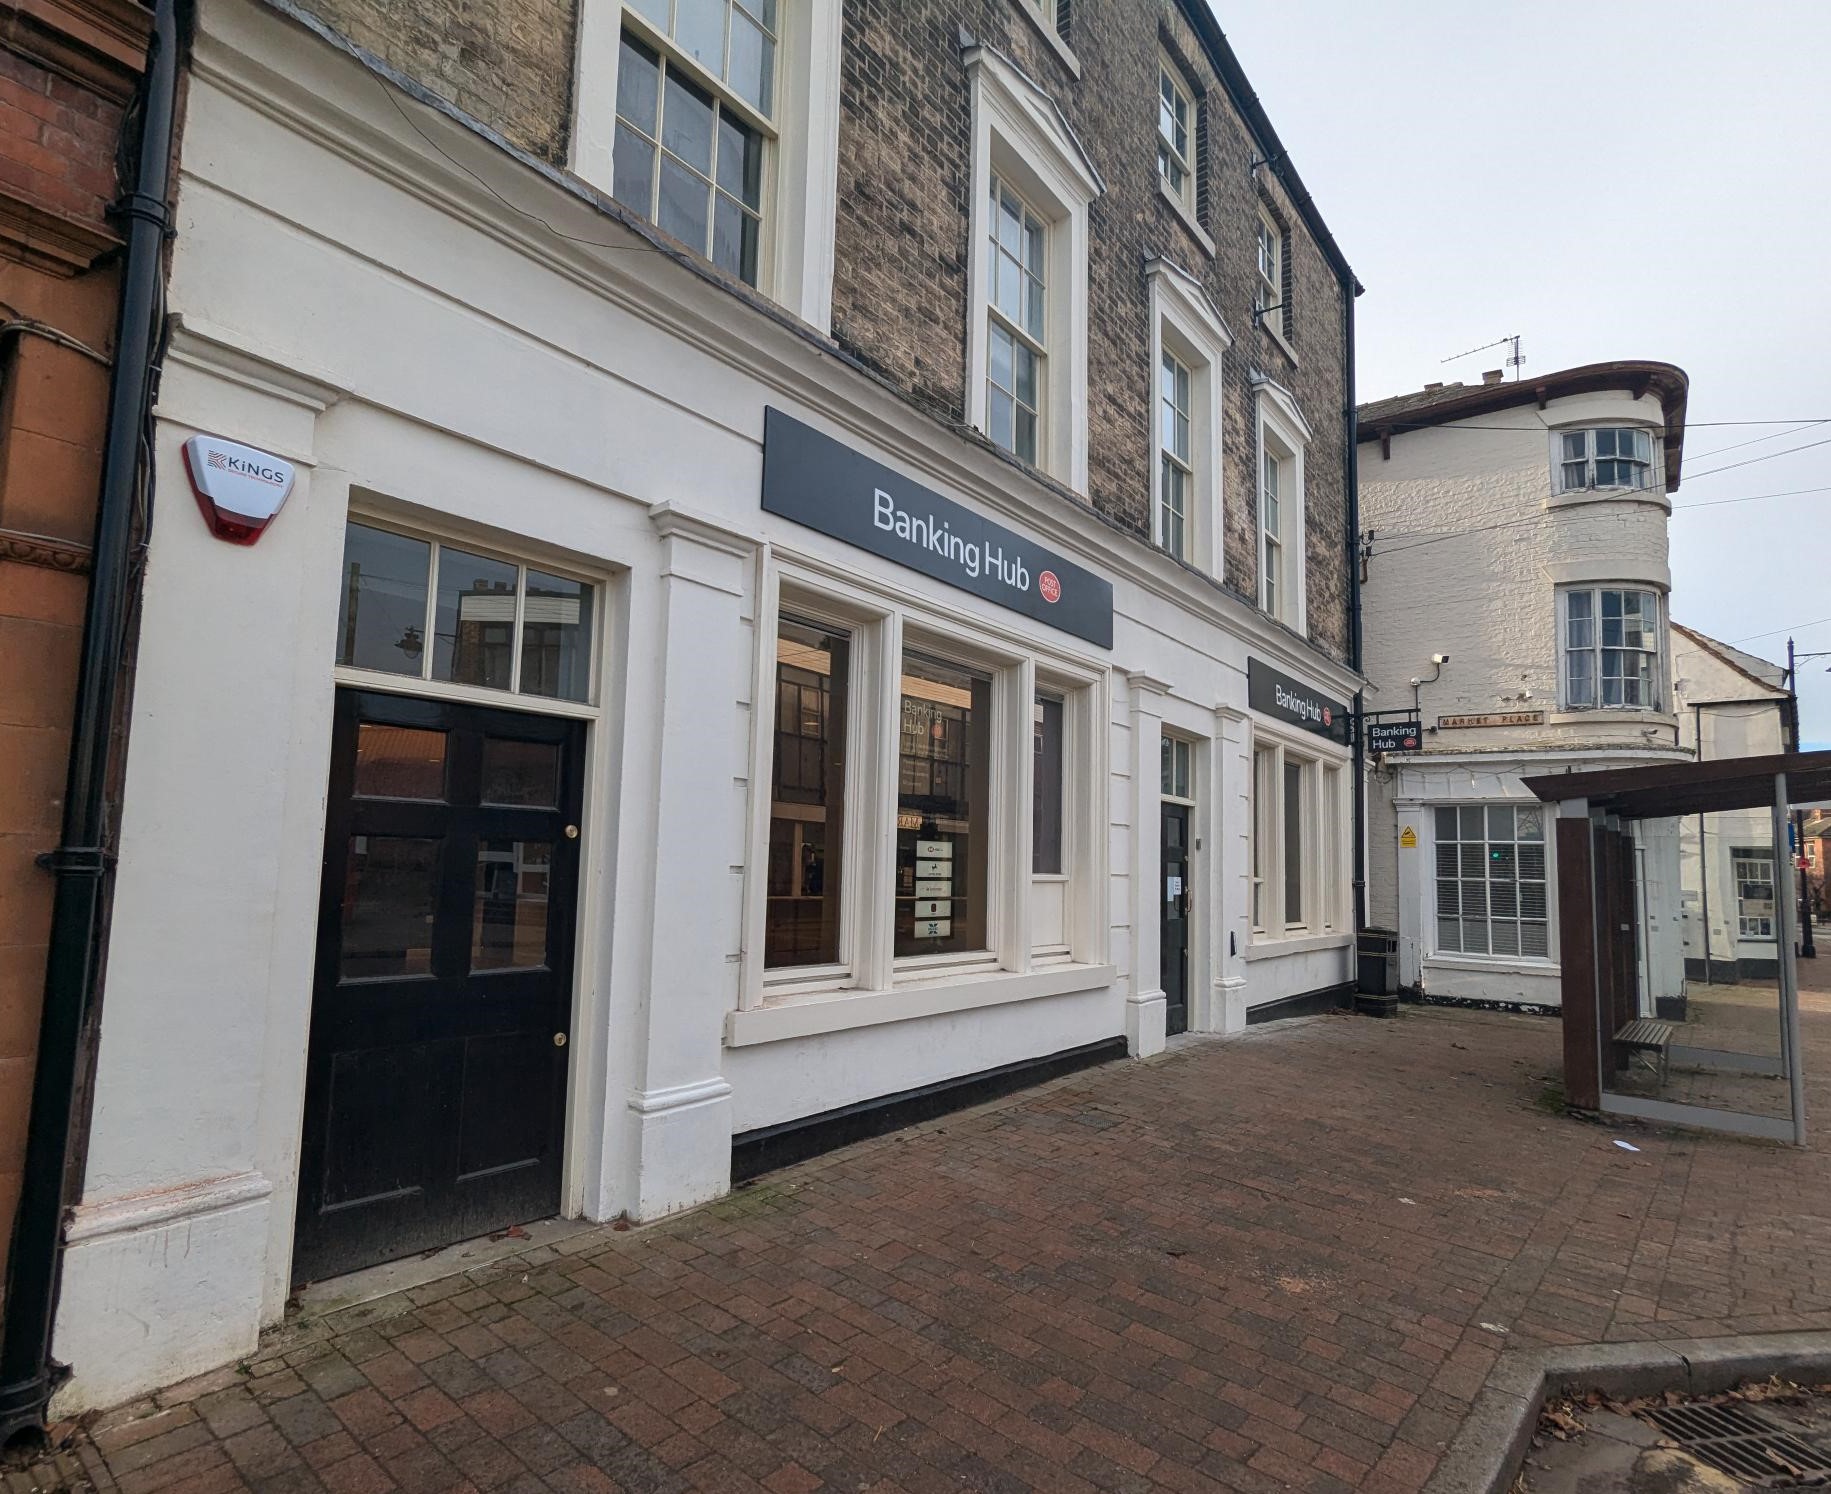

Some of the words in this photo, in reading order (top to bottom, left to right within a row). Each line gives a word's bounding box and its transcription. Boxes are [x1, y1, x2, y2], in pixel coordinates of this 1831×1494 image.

[873, 487, 980, 578] Banking
[985, 541, 1030, 592] Hub
[1276, 683, 1306, 720] Banking
[1306, 698, 1322, 722] Hub
[904, 699, 942, 724] Banking
[1442, 716, 1489, 726] MARKET
[1502, 714, 1539, 724] PLACE
[903, 718, 924, 735] Hub
[1372, 726, 1417, 737] Banking
[1372, 739, 1396, 749] Hub
